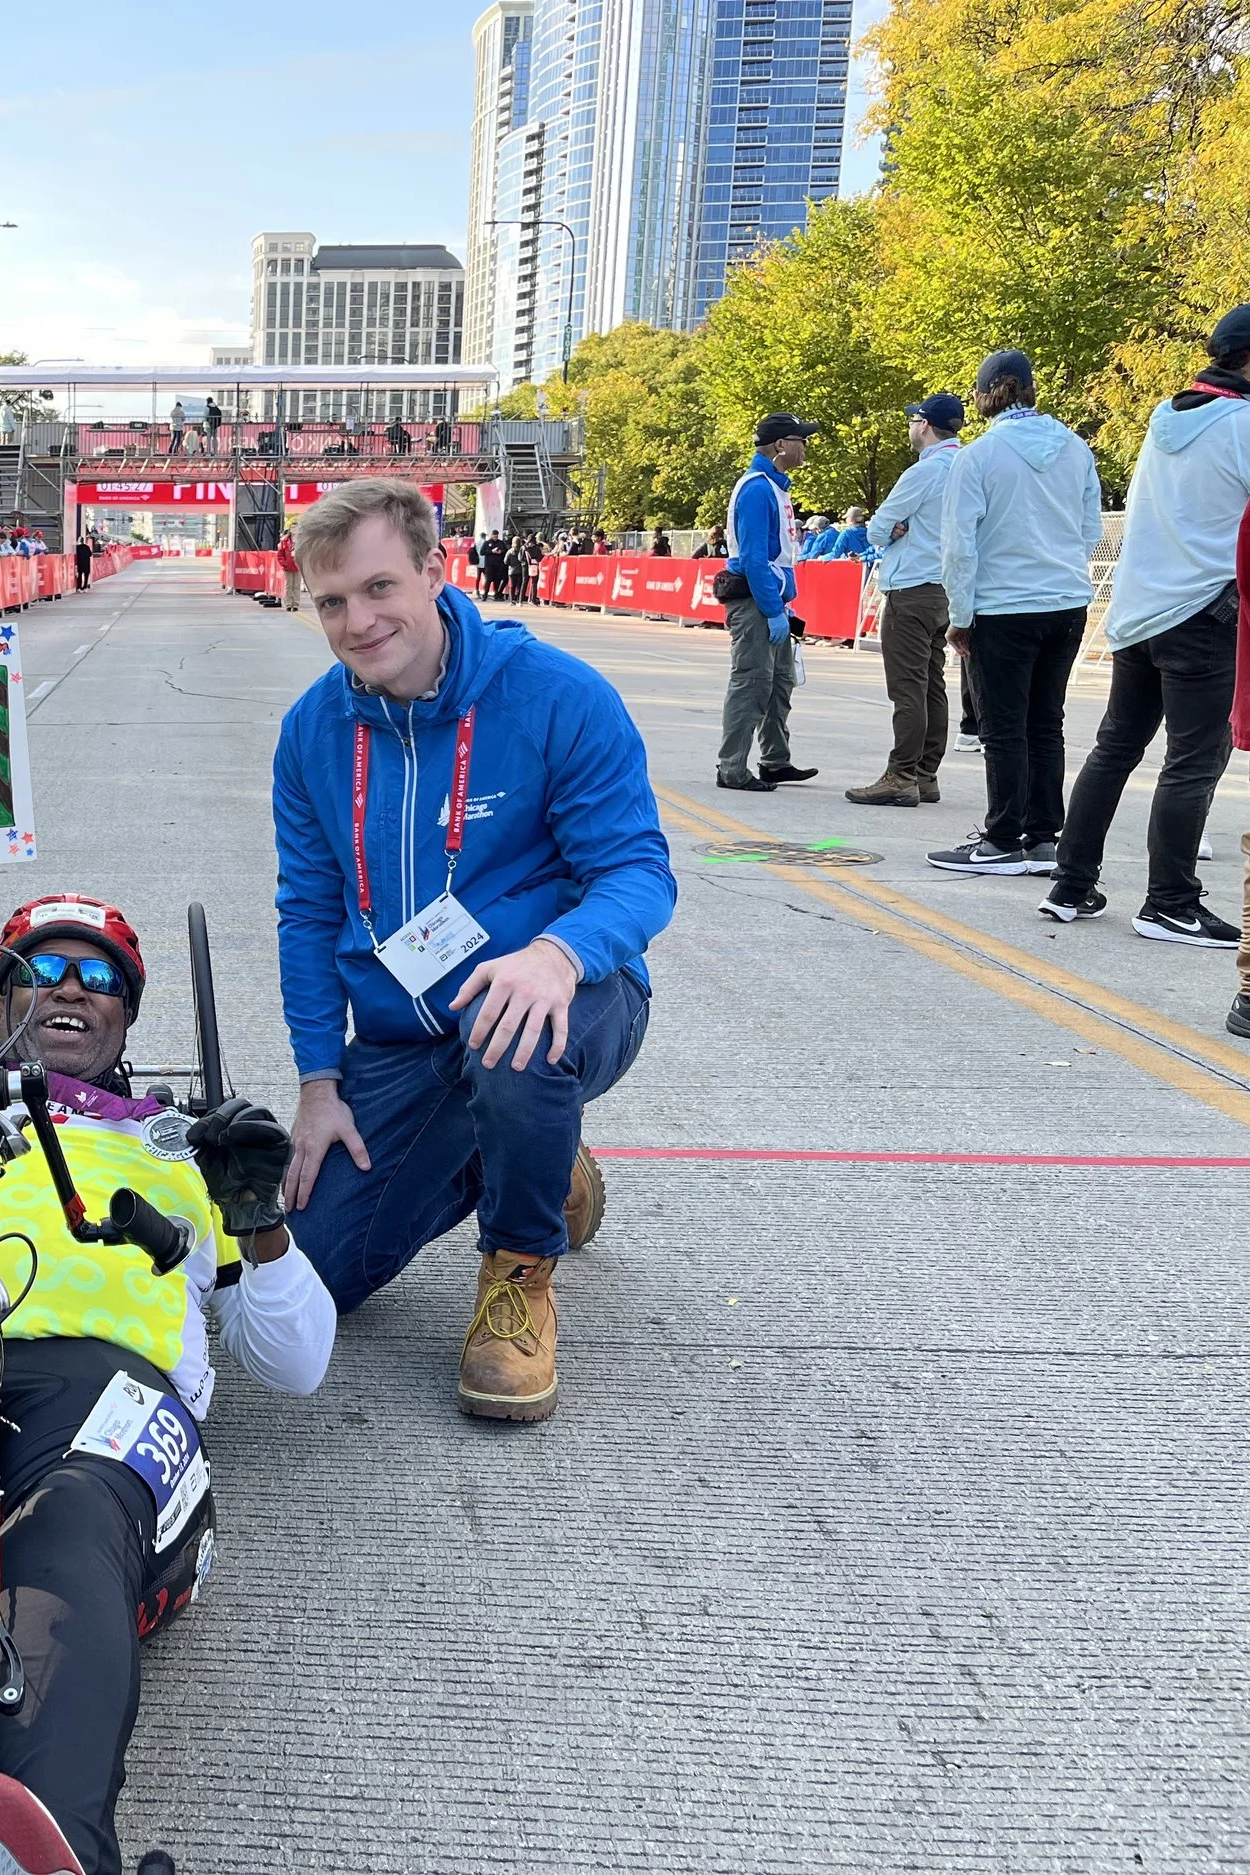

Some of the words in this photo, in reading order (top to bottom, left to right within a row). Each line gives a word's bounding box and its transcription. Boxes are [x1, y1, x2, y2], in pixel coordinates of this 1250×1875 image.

[356, 744, 363, 755] OF
[457, 760, 467, 797] AMERICA
[456, 798, 463, 808] OF
[453, 810, 461, 833] BANK
[354, 846, 360, 856] OF
[355, 857, 365, 894] AMERICA
[460, 932, 484, 954] 2024
[46, 1102, 85, 1117] EAM
[136, 1408, 188, 1485] 369
